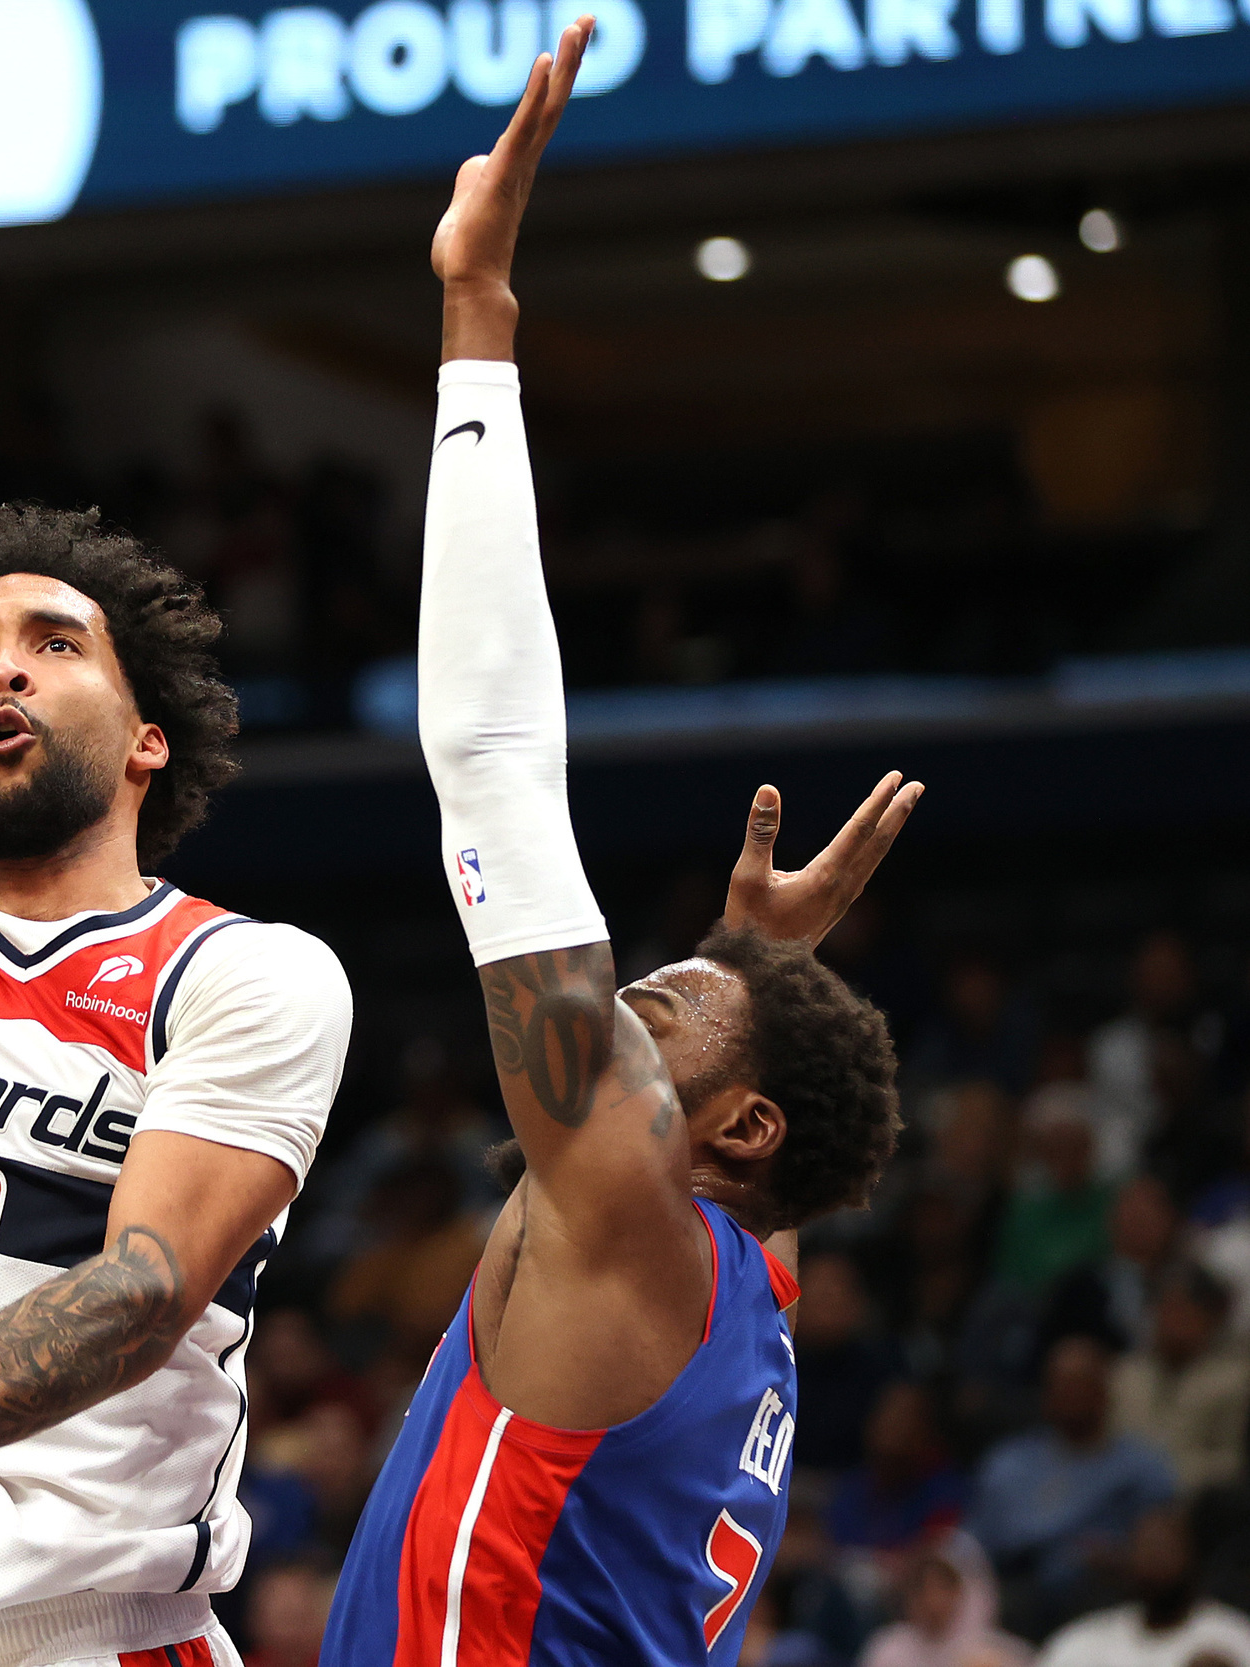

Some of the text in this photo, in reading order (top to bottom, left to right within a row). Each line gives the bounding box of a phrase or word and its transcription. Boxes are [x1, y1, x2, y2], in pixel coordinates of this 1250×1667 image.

[174, 0, 1250, 134] PROUD PART
[65, 990, 148, 1026] Robinhood
